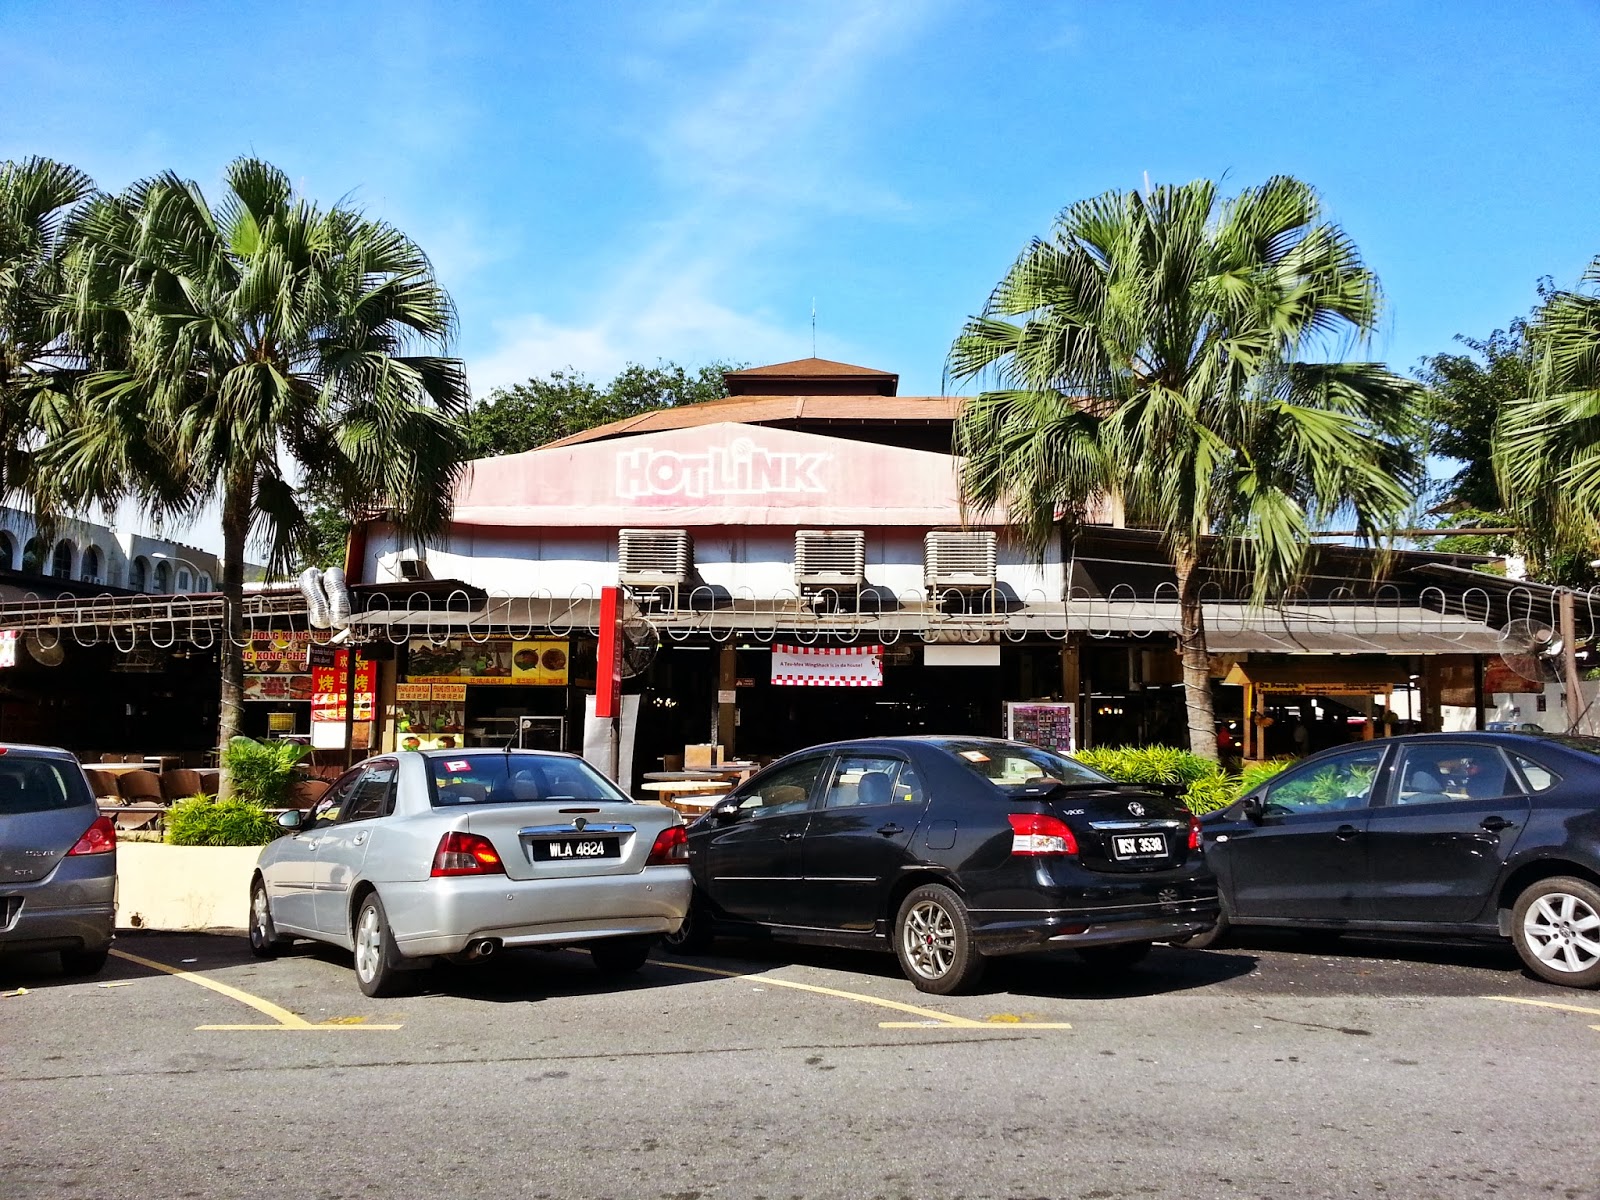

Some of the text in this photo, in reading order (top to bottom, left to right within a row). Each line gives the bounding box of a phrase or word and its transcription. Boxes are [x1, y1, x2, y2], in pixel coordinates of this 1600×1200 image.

[252, 631, 278, 640] HONG
[282, 631, 309, 640] KONG
[256, 651, 283, 660] KONG
[446, 761, 467, 771] P
[549, 841, 604, 857] WLA 4824
[1138, 837, 1163, 852] 3538
